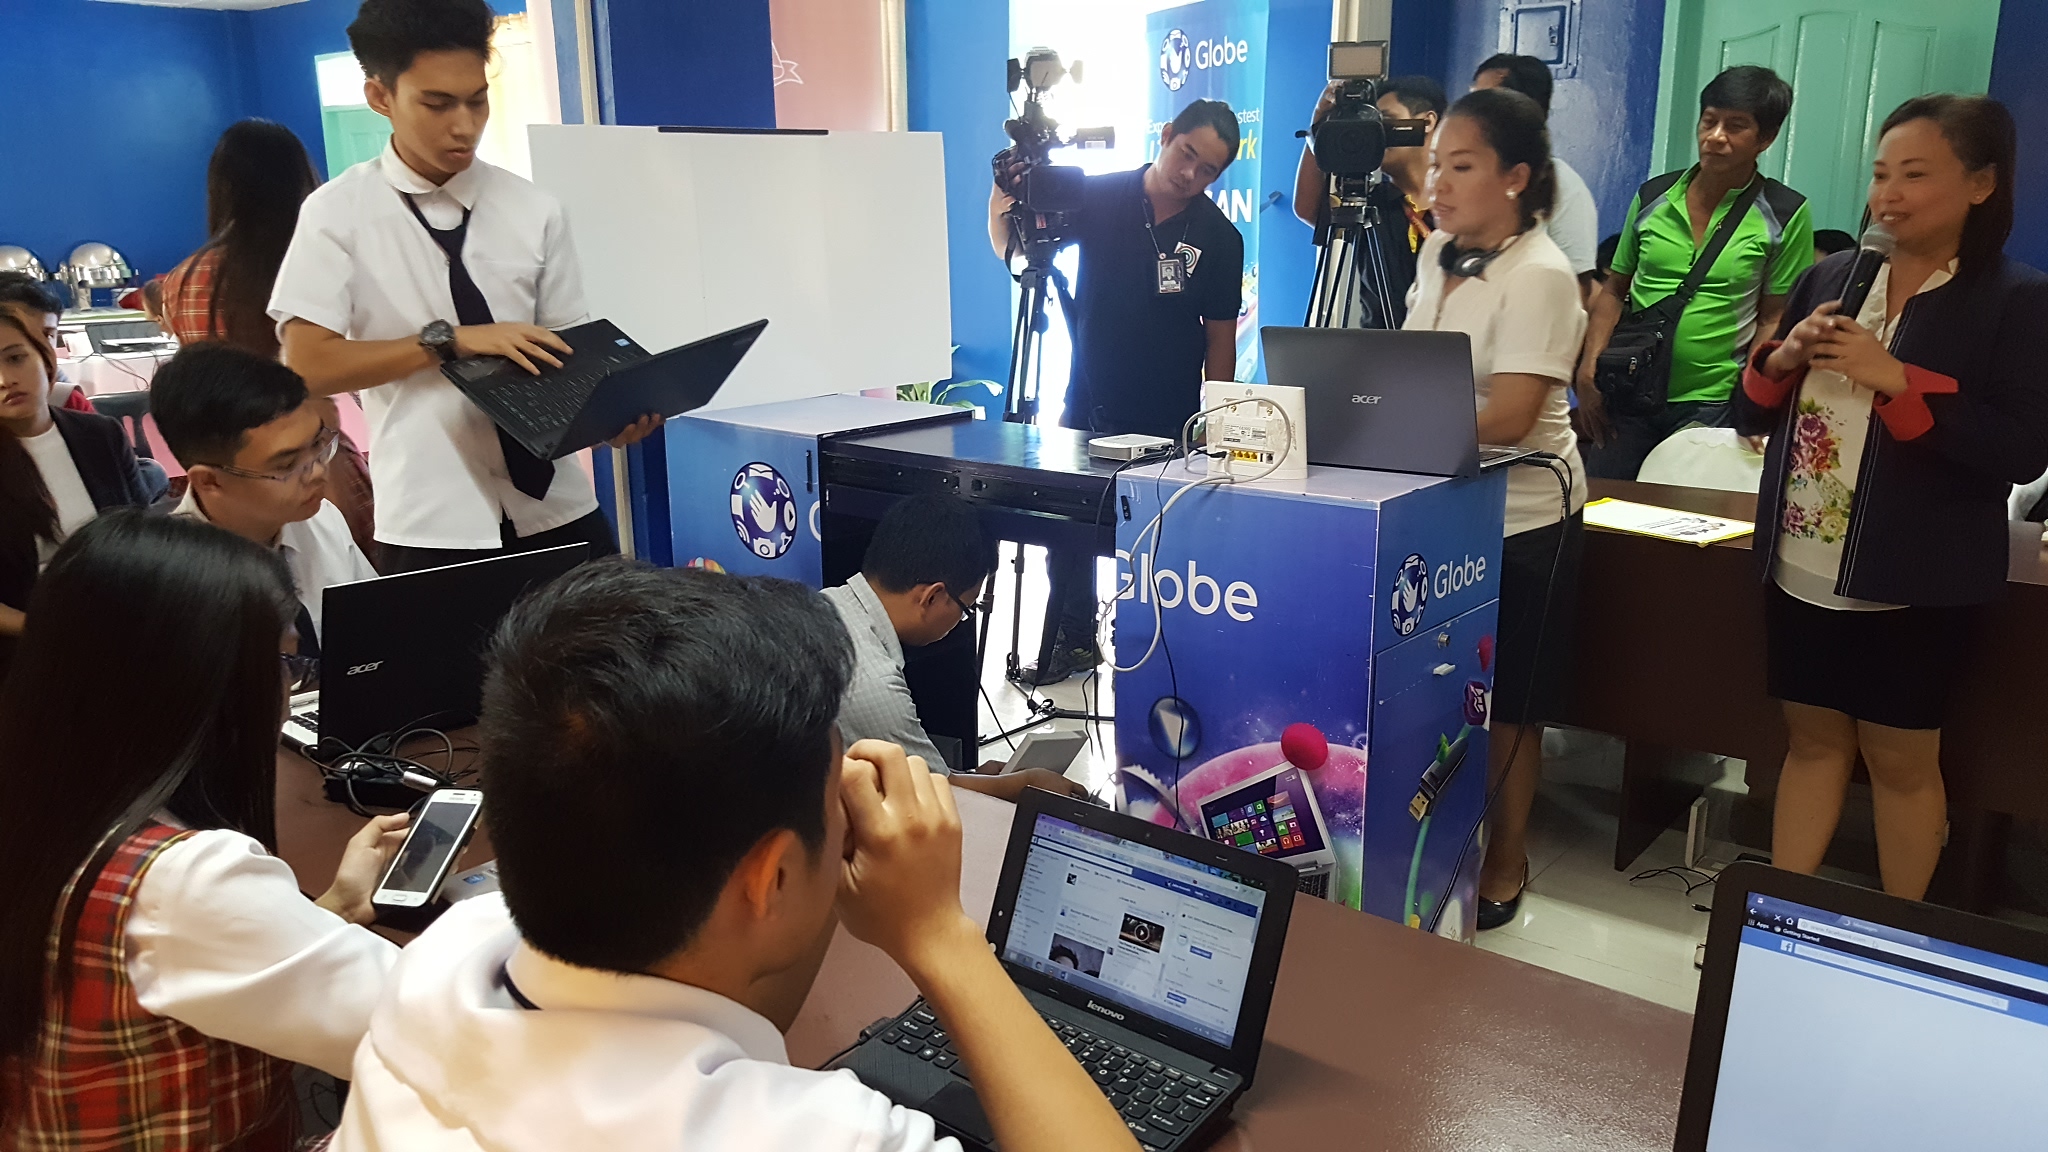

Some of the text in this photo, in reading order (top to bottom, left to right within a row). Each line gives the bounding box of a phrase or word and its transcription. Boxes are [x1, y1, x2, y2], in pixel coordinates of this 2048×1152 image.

[1195, 35, 1248, 70] Globe
[1236, 107, 1260, 124] stest
[1351, 394, 1382, 405] acer
[1116, 549, 1258, 622] Globe
[1434, 554, 1486, 599] Globe
[346, 660, 384, 676] acer
[1756, 921, 1820, 943] Apps Getting Started
[1087, 1000, 1125, 1021] lenovo
